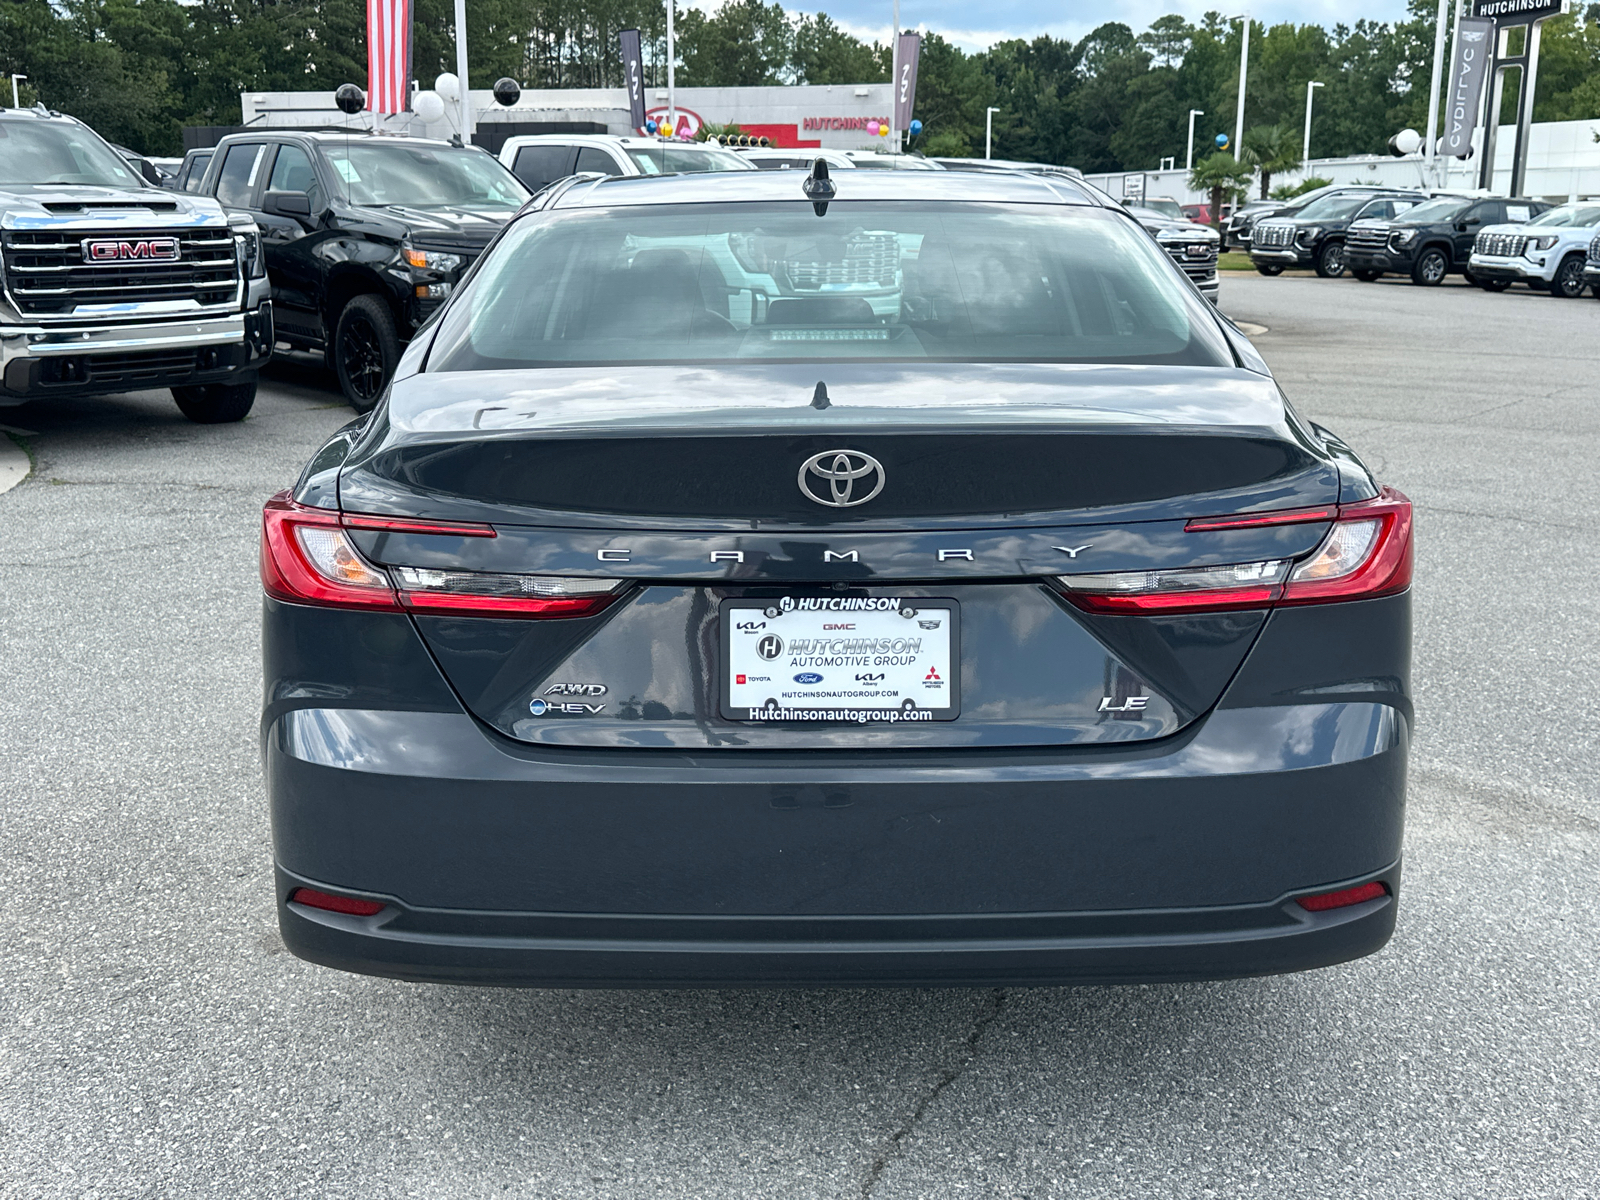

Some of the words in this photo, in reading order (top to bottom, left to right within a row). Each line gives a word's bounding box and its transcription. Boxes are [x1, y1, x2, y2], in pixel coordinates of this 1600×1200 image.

[1480, 0, 1551, 16] HUTCHINSON
[647, 115, 691, 136] KA
[90, 241, 175, 259] GMC
[597, 543, 1093, 563] CAMRY
[797, 598, 901, 611] HUTCHINSON
[788, 637, 922, 655] HUTCHINSON
[790, 656, 870, 667] AUTOMOTIVE
[874, 656, 916, 667] GROUP
[543, 683, 607, 696] AWD
[781, 690, 899, 699] HUTCHINSONAUTOGROUP.COM
[547, 702, 606, 714] HEV
[1098, 696, 1150, 712] LE
[749, 708, 933, 722] Hutchinsonautogroup.com
